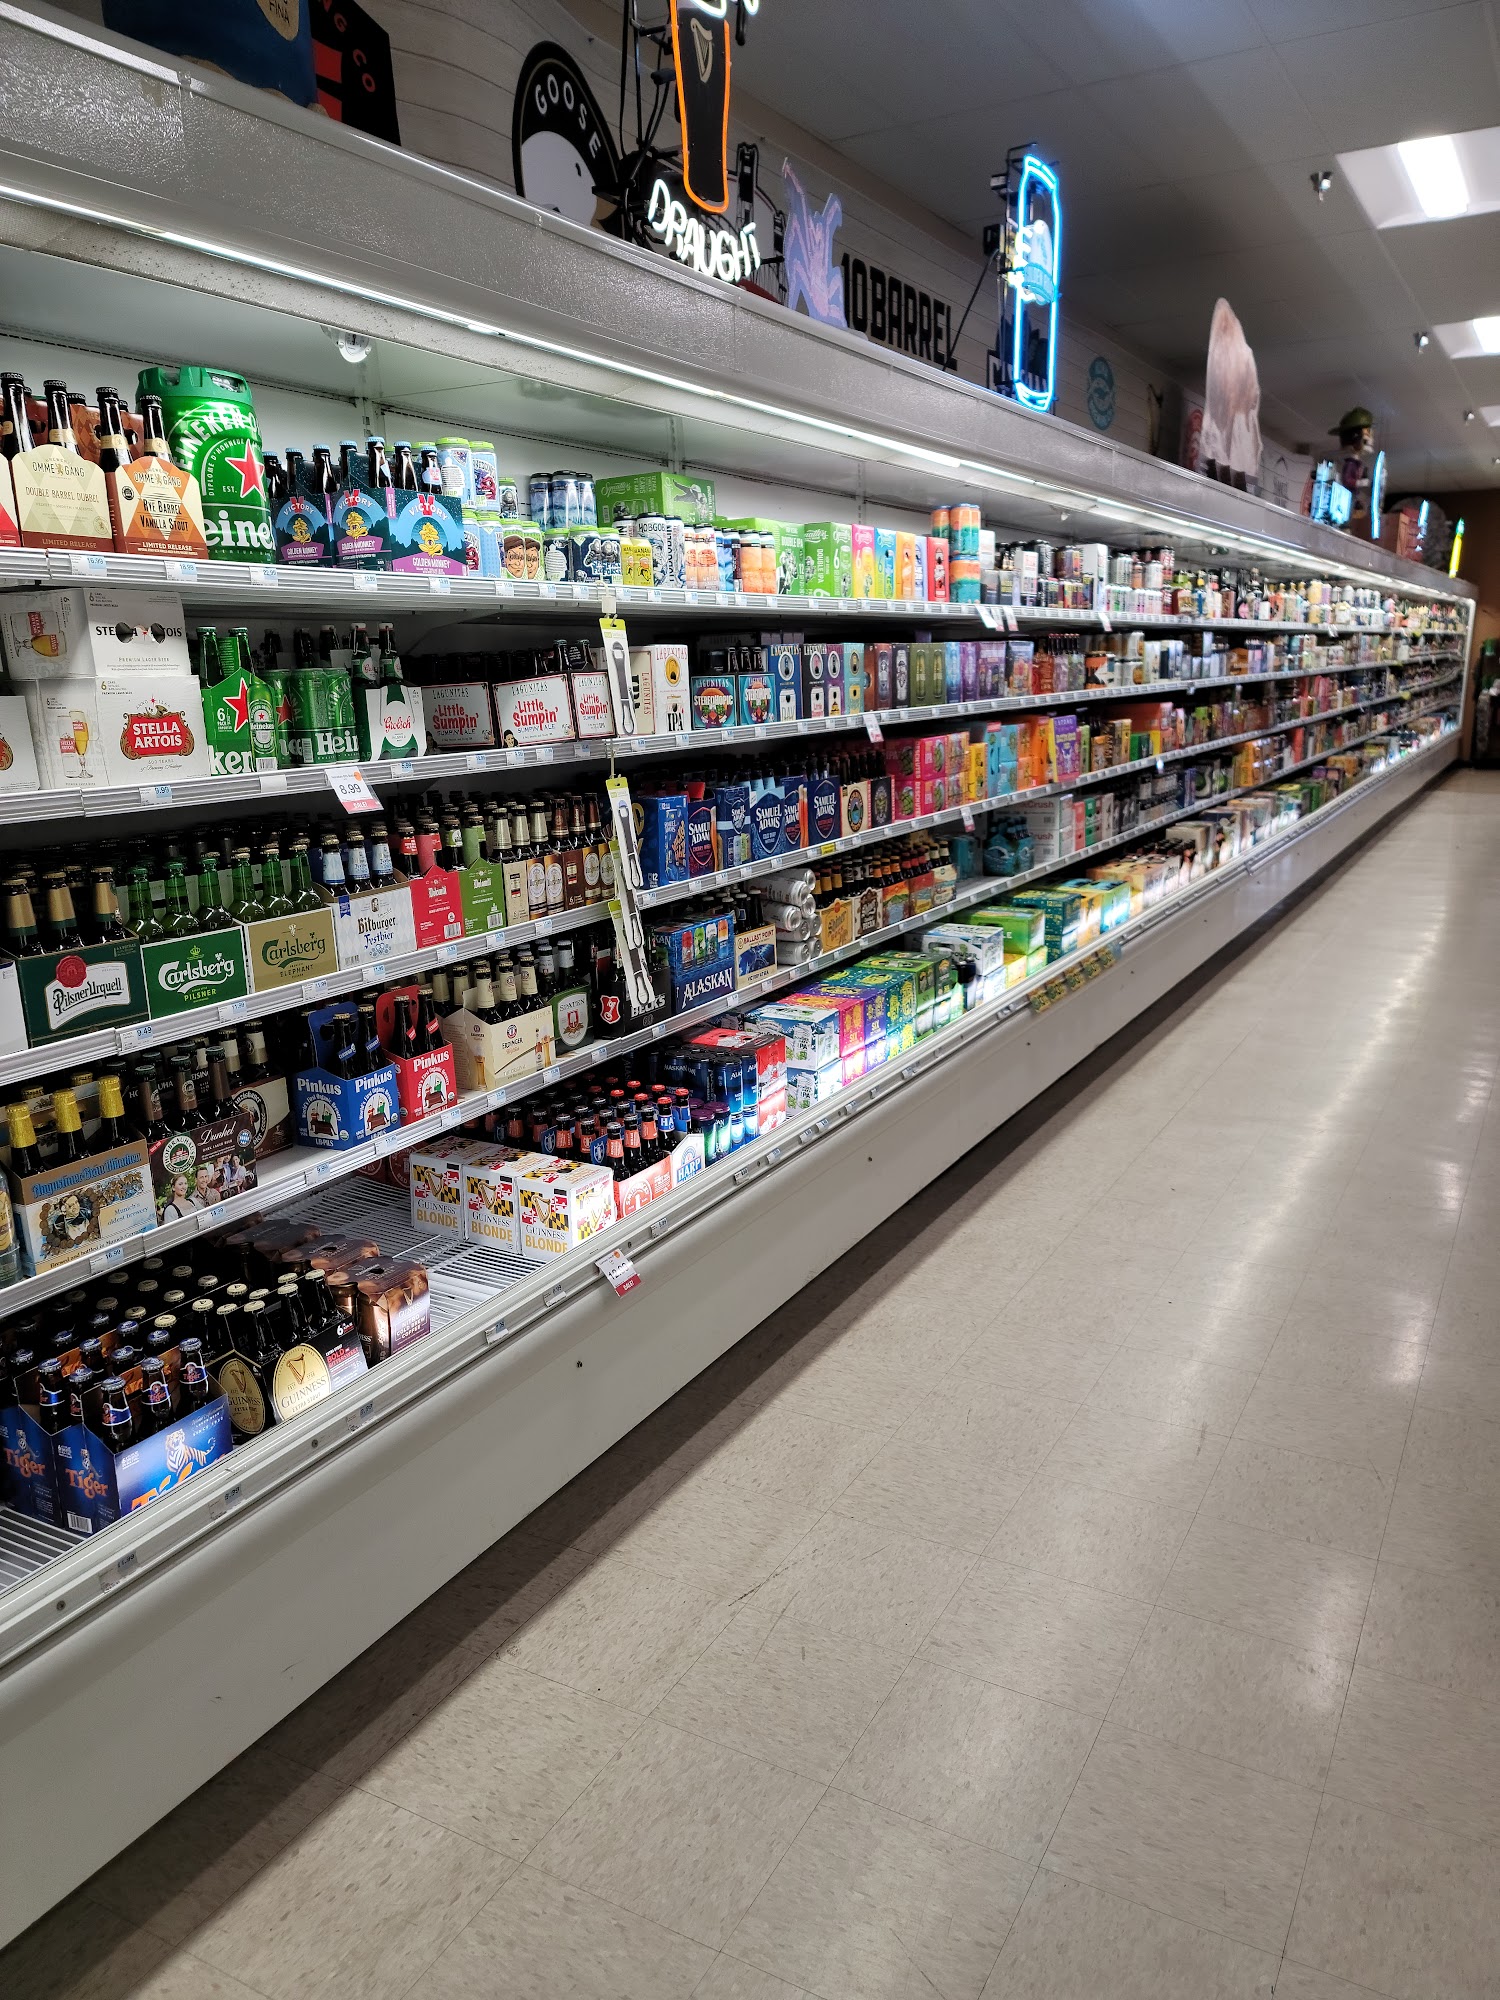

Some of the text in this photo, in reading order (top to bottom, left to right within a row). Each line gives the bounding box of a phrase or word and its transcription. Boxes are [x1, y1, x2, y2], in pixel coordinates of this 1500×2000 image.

[535, 73, 602, 160] GOOSE
[648, 179, 761, 283] DRAUGHT
[32, 461, 55, 474] OMME
[64, 467, 85, 478] GANG
[162, 476, 182, 488] GANG
[222, 485, 238, 494] EST.
[25, 486, 100, 504] DOUBLE BARREL DUBBEL
[339, 496, 374, 510] VICTORY
[143, 500, 182, 515] RYE BARREL
[284, 502, 315, 517] VICTORY
[408, 502, 450, 521] VICTORY
[139, 515, 188, 532] VANILLA STOUT
[638, 522, 666, 533] HOBGOB
[42, 538, 68, 547] LIMITED
[142, 541, 166, 550] LIMITED
[167, 543, 193, 551] RELEASE
[816, 549, 824, 574] DOUBLE
[834, 548, 840, 570] 6
[89, 592, 94, 602] 6
[656, 647, 688, 661] LAGUNITAS
[101, 681, 107, 690] 6
[511, 681, 549, 698] LAGUNITAS
[577, 676, 606, 688] LAGUNITAS
[432, 686, 470, 700] LAGUNITAS
[582, 693, 600, 705] Little
[641, 672, 652, 716] LAGUNITAS
[216, 707, 226, 721] 6
[438, 703, 465, 717] Little
[517, 698, 544, 713] Little
[579, 701, 610, 720] Sumpin'
[249, 722, 275, 730] Heineken
[384, 715, 412, 734] Grolsch
[432, 712, 480, 735] Sumpin'
[513, 707, 559, 732] Sumpin'
[666, 711, 684, 733] IPA
[132, 721, 181, 736] STELLA
[134, 735, 183, 749] ARTOIS
[154, 786, 170, 795] 9.99
[338, 783, 362, 795] 8.99
[813, 792, 837, 809] SAMUEL
[755, 804, 782, 821] SAMUEL
[816, 803, 835, 820] ADAMS
[758, 815, 780, 832] ADAMS
[691, 832, 711, 846] ADAM
[357, 915, 398, 935] Bitburger
[743, 929, 775, 945] BALLAST POINT
[261, 932, 326, 967] Carlsberg
[158, 953, 236, 991] Carlsberg
[279, 964, 314, 979] ELEPHANT
[184, 988, 217, 1002] PILSNER
[681, 966, 734, 1010] ALASKAN
[53, 978, 125, 1016] Pilsner Urquell
[137, 1026, 152, 1037] 9.49
[413, 1050, 450, 1073] Pinkus
[296, 1078, 342, 1096] Pinkus
[355, 1070, 393, 1093] Pinkus
[197, 1121, 236, 1147] Dunkel
[677, 1156, 701, 1182] HARP
[417, 1199, 458, 1215] GUINNESS
[107, 1206, 149, 1226] oldest brewery
[416, 1208, 459, 1229] BLONDE
[472, 1211, 512, 1228] GUINNESS
[471, 1222, 513, 1243] BLONDE
[526, 1224, 567, 1240] GUINNESS
[525, 1234, 568, 1254] BLONDE
[50, 1257, 69, 1269] Brewed
[396, 1315, 426, 1336] COLD BREW
[402, 1313, 420, 1327] NITRO
[336, 1324, 343, 1336] 6
[401, 1324, 421, 1339] COFFEE
[326, 1349, 345, 1363] BOLD
[148, 1390, 167, 1403] Tiger
[281, 1376, 327, 1409] GUINNESS
[228, 1396, 263, 1407] GUINNESS
[292, 1402, 306, 1413] EXTRA
[4, 1447, 46, 1478] Tiger
[65, 1468, 109, 1499] Tiger
